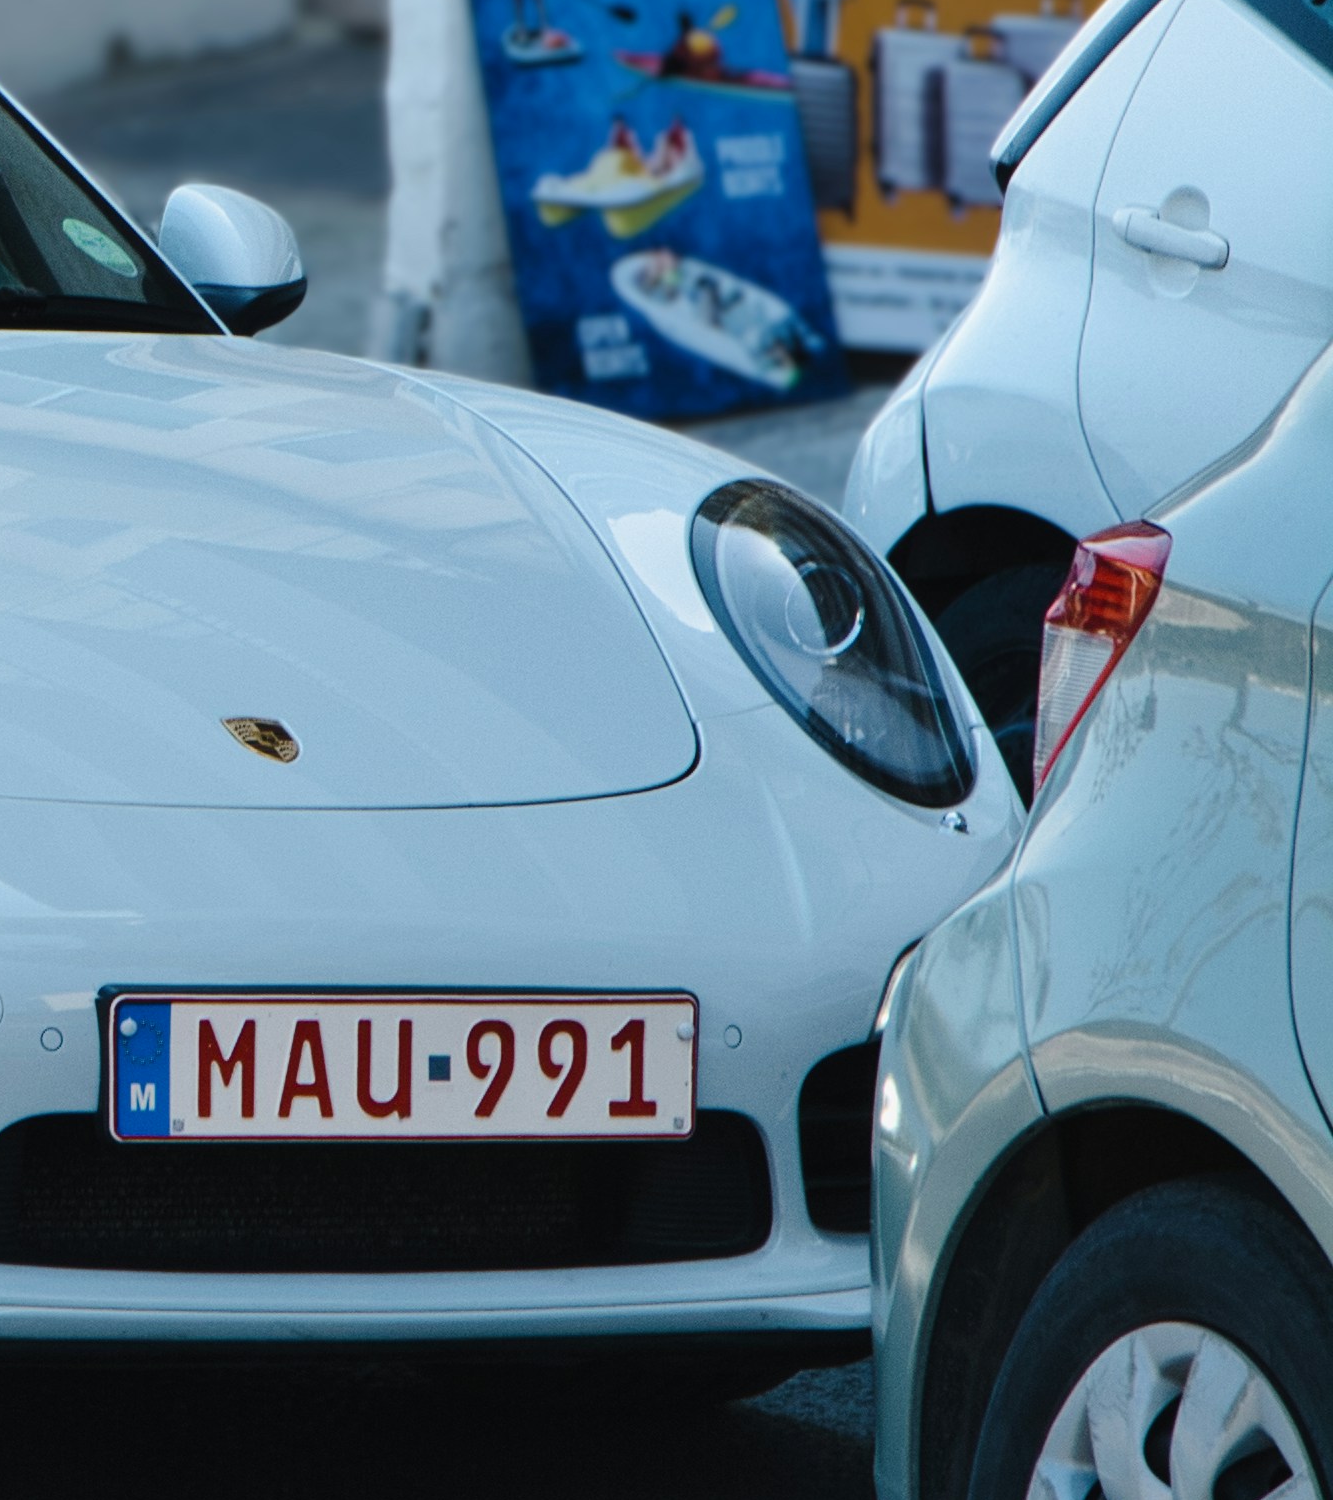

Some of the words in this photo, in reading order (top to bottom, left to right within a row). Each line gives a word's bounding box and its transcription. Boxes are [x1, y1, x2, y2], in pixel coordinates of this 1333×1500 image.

[723, 164, 783, 198] BOATS
[577, 313, 630, 347] OPEN
[583, 343, 649, 380] BOATS
[197, 1018, 413, 1121] MAU
[465, 1018, 658, 1120] 991
[130, 1083, 156, 1111] M
